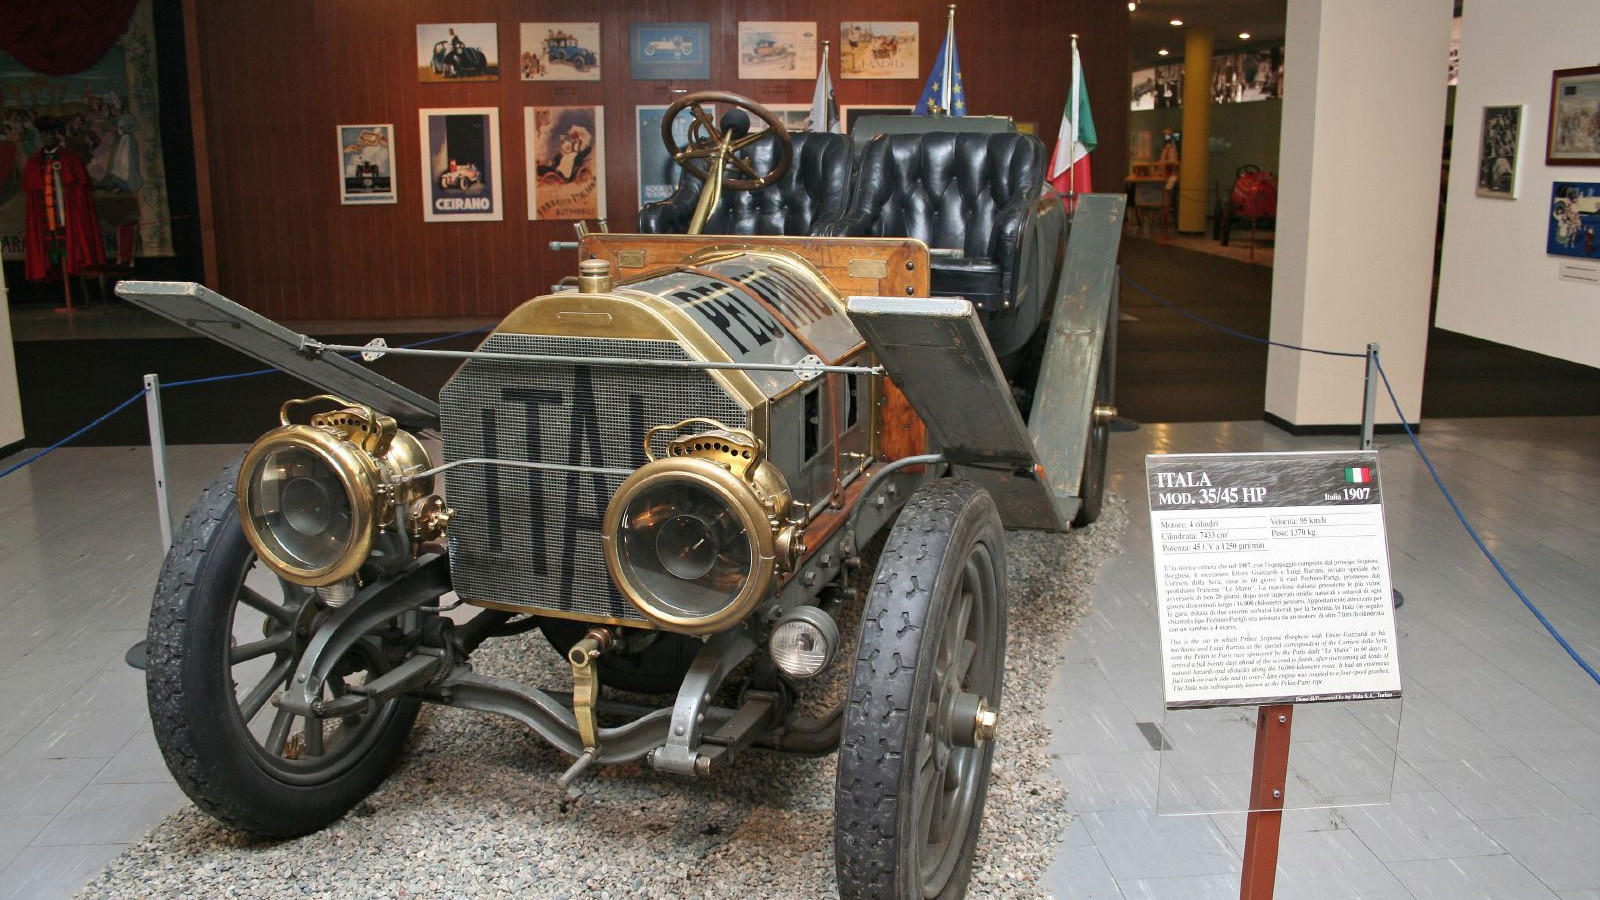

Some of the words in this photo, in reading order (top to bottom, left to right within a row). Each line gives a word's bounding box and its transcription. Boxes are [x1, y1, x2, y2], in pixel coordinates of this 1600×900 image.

[435, 197, 490, 211] CEIRANO
[1156, 471, 1212, 488] ITALA
[1159, 492, 1196, 505] MOD.
[1198, 487, 1239, 504] 35/45
[1242, 487, 1267, 502] HP
[1343, 488, 1371, 500] 1907
[1161, 532, 1197, 540] Cilindrata:
[1307, 528, 1316, 537] kg
[1162, 544, 1191, 552] Potenza:
